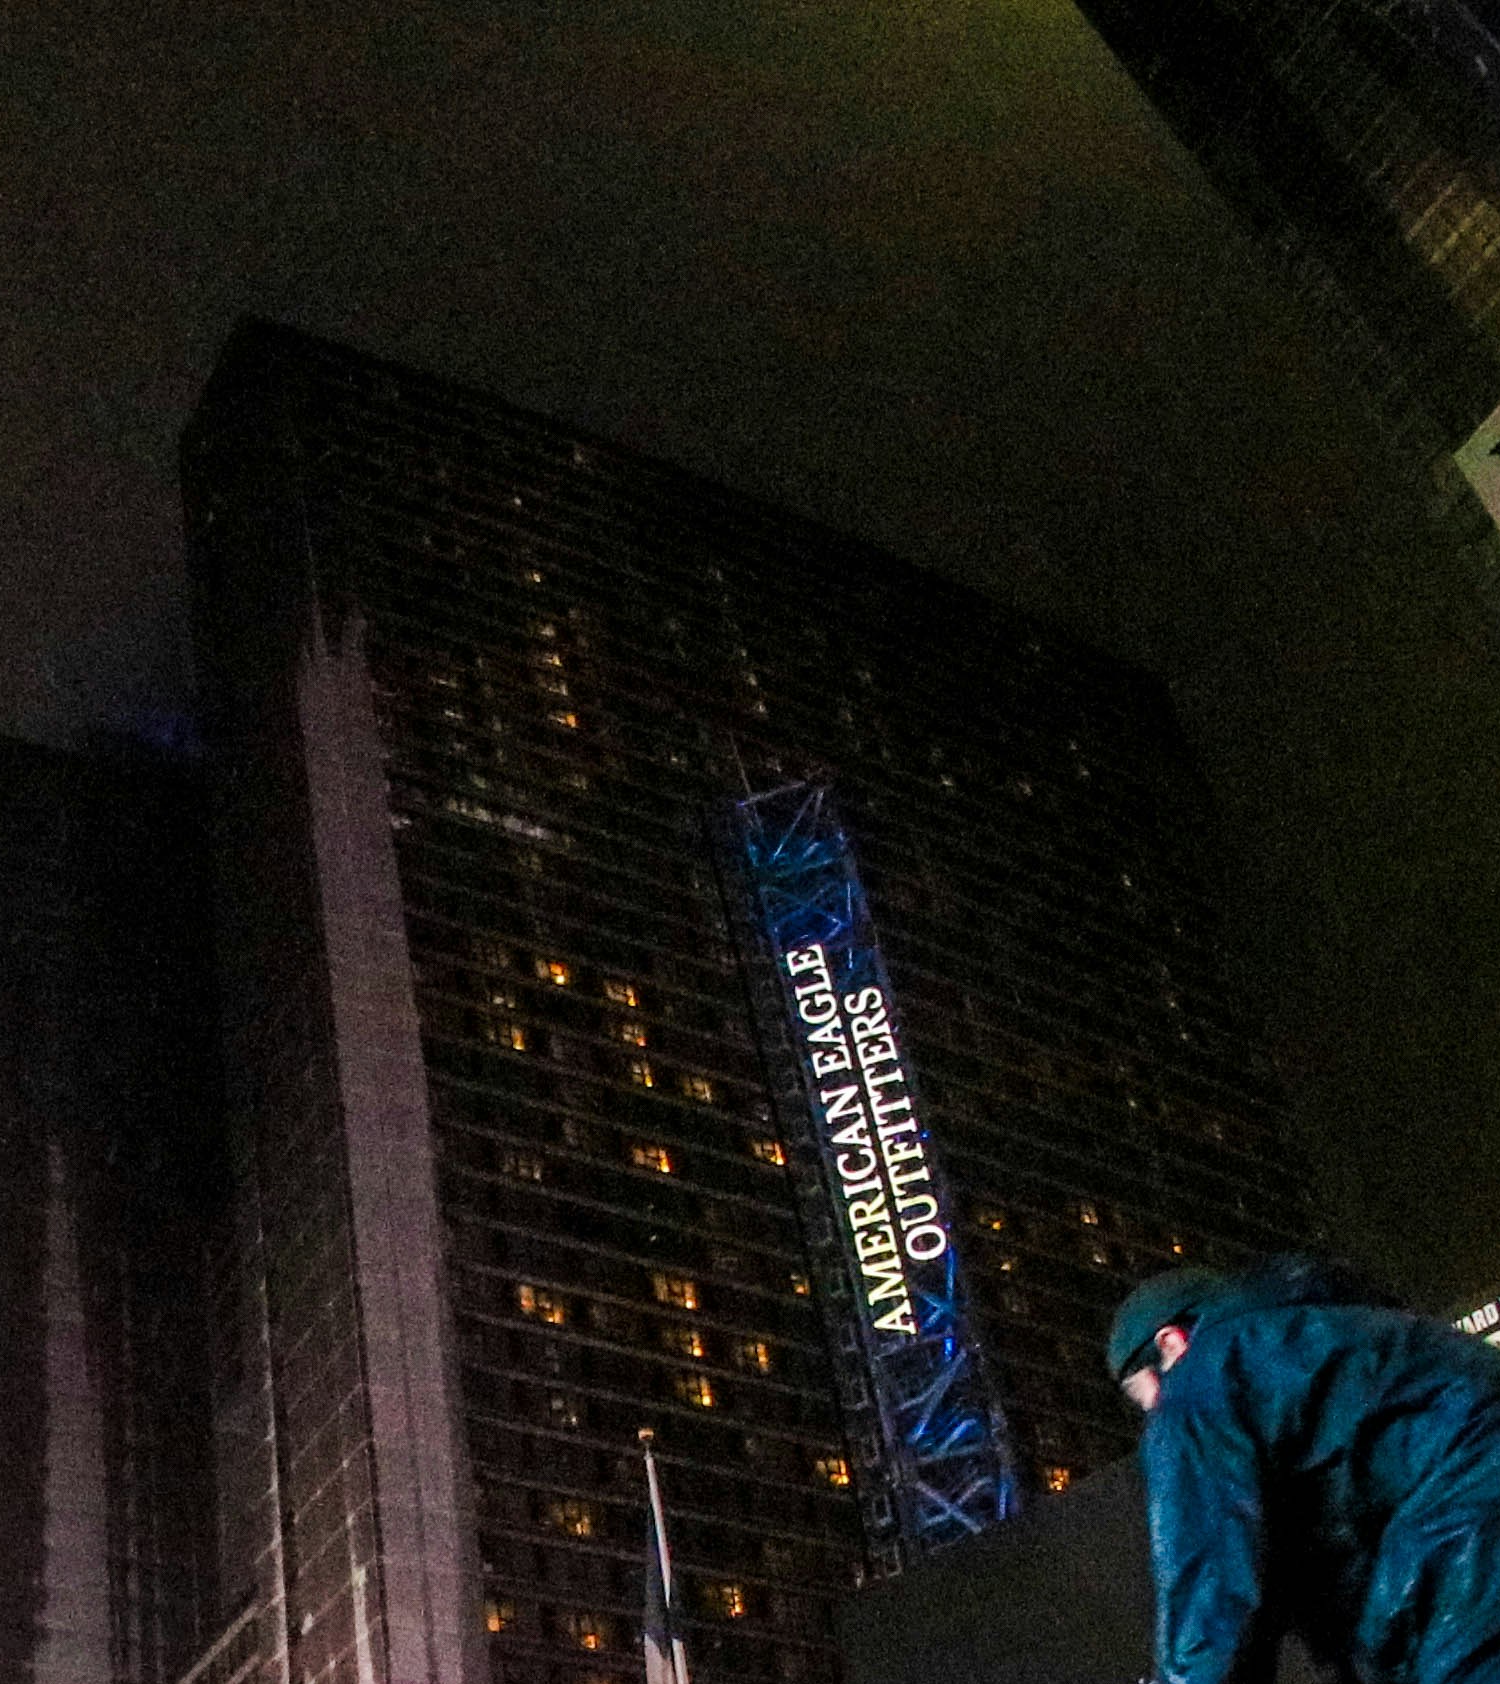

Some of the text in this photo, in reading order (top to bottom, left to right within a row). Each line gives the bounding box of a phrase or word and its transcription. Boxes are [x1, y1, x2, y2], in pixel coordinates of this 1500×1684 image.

[787, 942, 917, 1337] AMERICAN EAGLE
[842, 987, 947, 1263] OUTFITTERS
